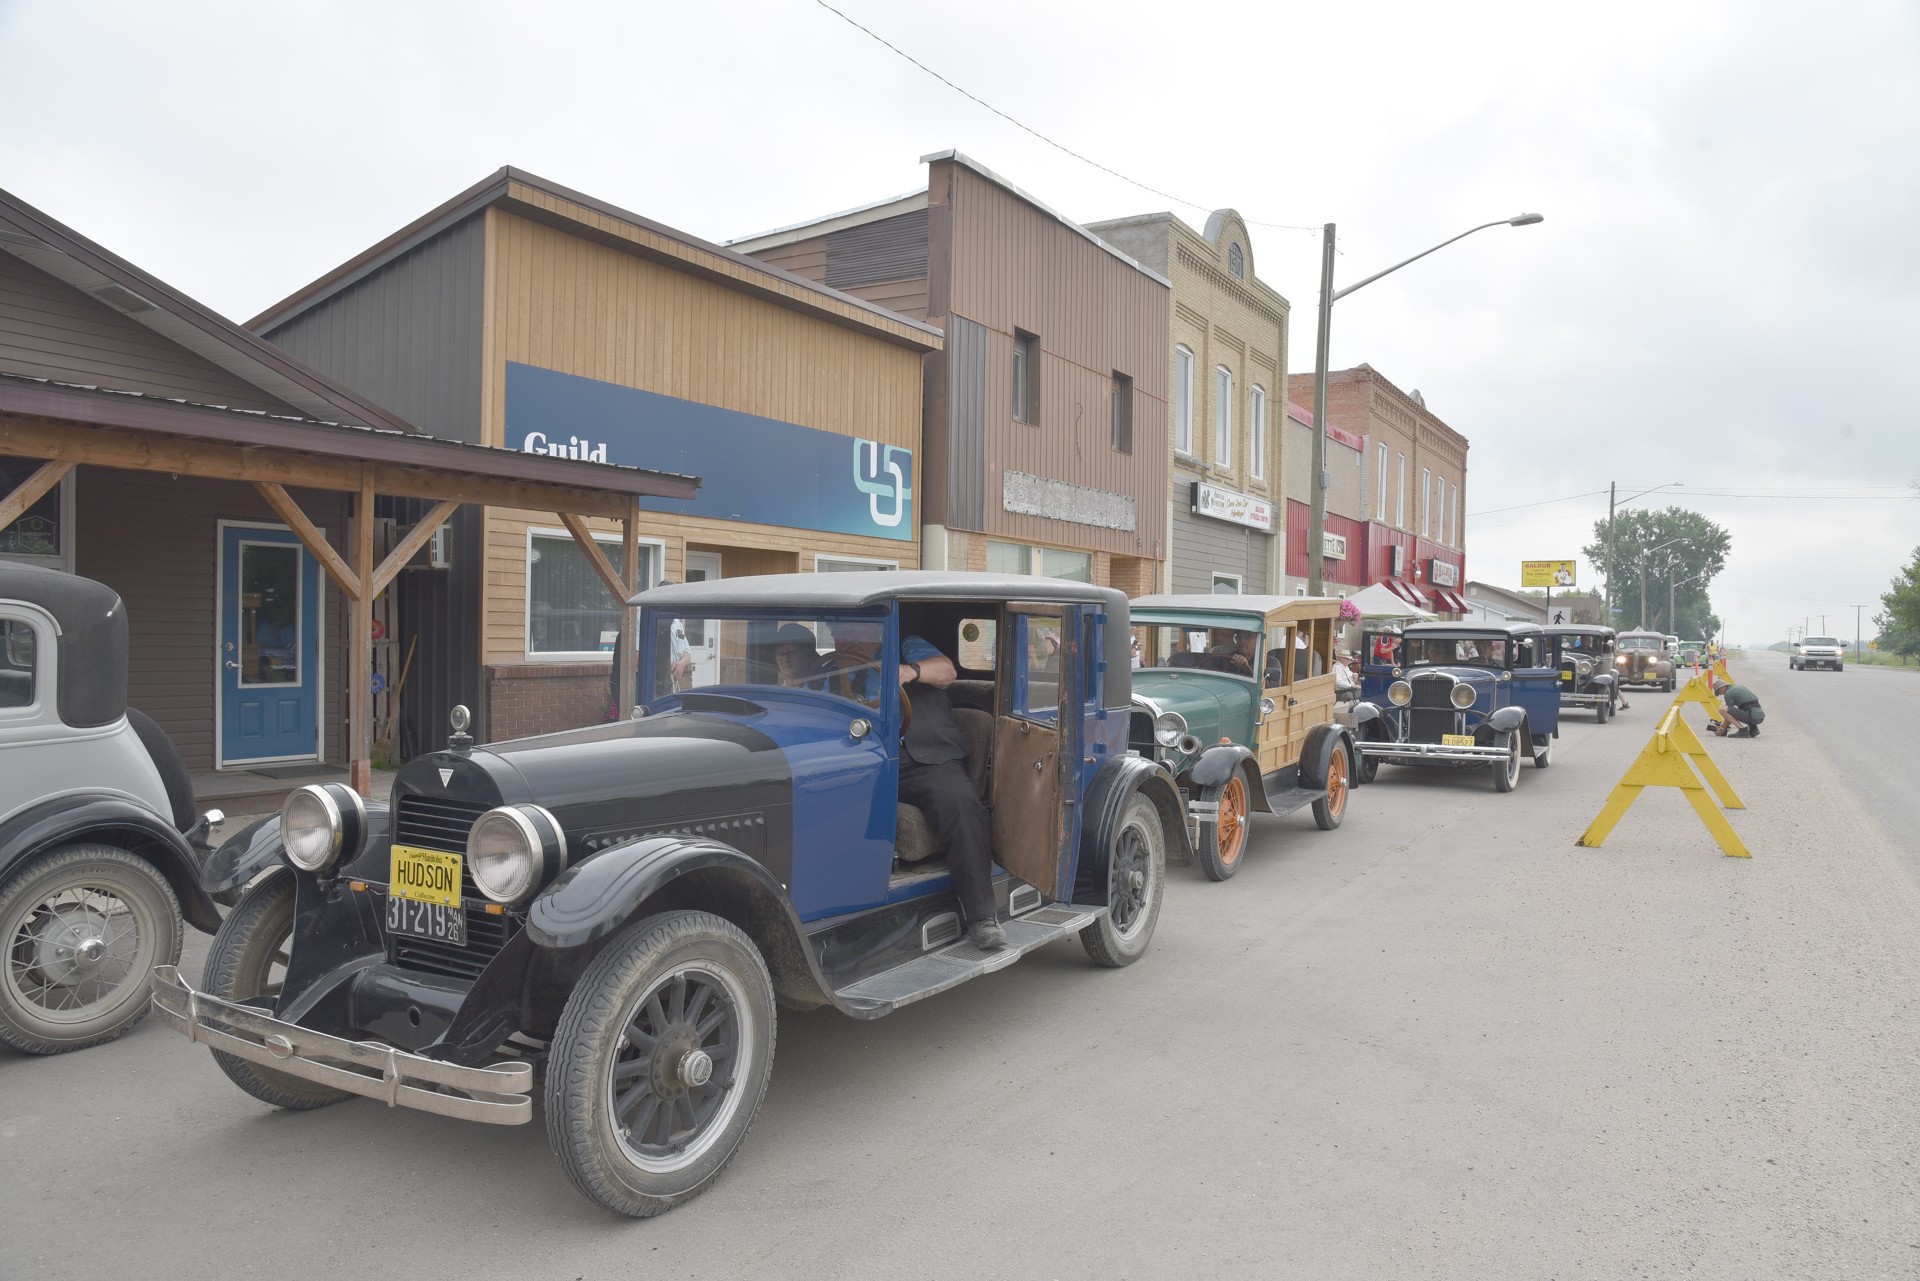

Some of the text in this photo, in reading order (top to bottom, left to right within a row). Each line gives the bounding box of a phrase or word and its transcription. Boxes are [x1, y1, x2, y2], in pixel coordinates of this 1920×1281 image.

[524, 431, 607, 463] Guild
[423, 853, 442, 864] Manitoba
[397, 860, 453, 892] HUDSON
[414, 891, 435, 900] Collector
[448, 922, 459, 941] 26
